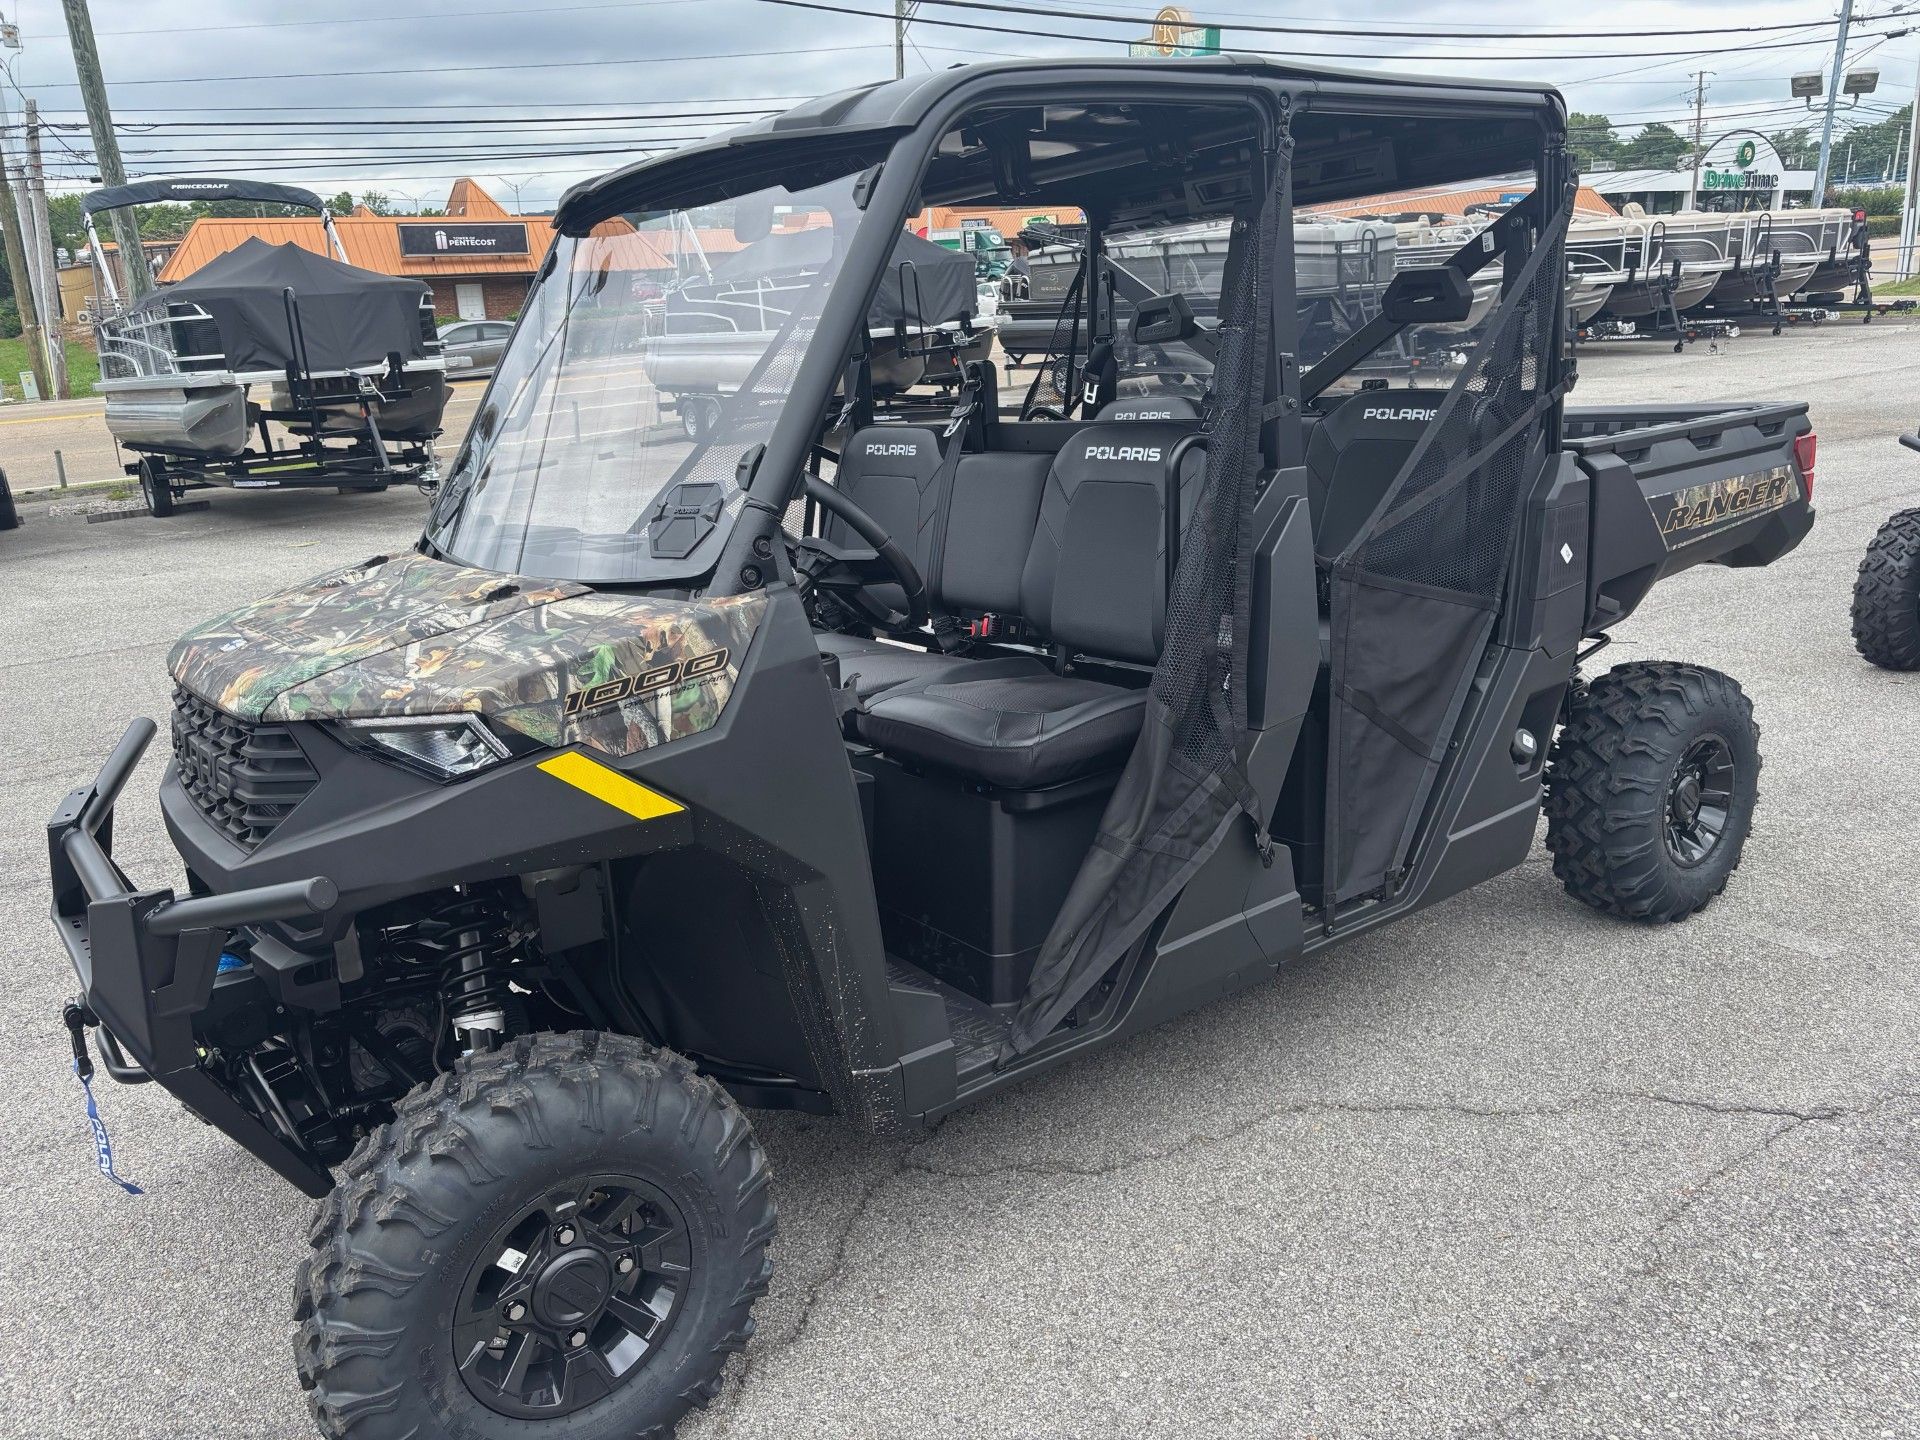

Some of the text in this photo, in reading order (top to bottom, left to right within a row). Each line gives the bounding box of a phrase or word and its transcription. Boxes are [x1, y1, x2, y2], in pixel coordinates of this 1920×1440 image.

[1704, 169, 1779, 190] DriveTime
[866, 444, 917, 456] POLARIS
[1085, 446, 1162, 462] POLARIS
[1663, 476, 1787, 533] RANGER
[563, 647, 732, 716] 1000
